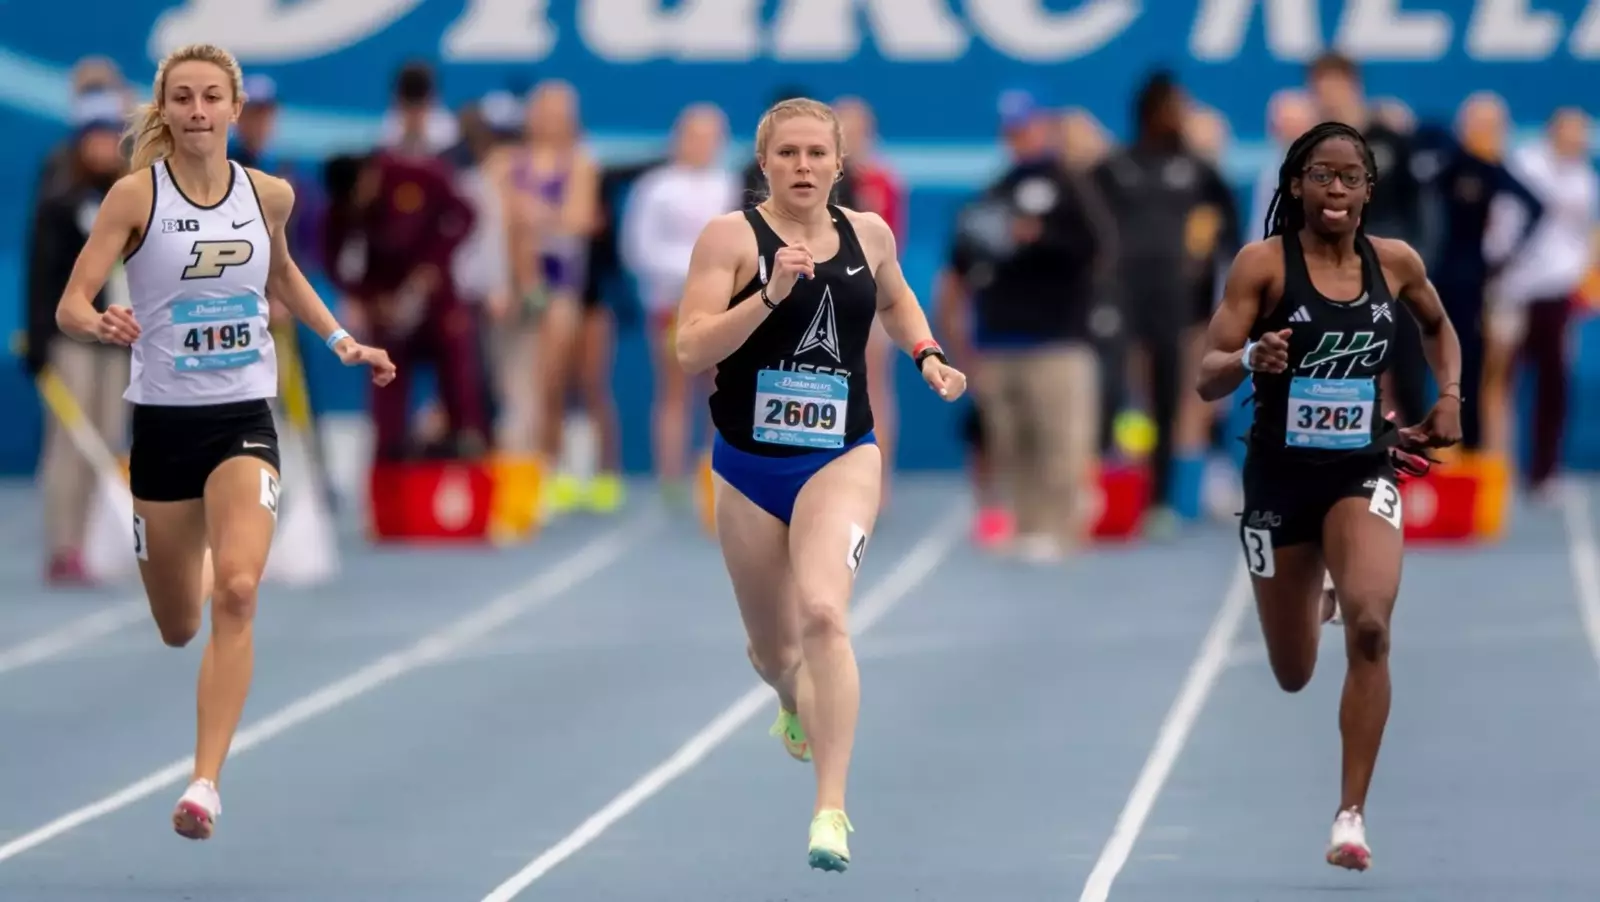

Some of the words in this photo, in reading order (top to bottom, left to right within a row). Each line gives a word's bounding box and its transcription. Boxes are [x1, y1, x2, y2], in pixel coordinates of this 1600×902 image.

[180, 239, 254, 281] P
[184, 323, 251, 352] 4195
[764, 399, 837, 430] 2609
[1297, 405, 1364, 431] 3262
[1377, 484, 1398, 519] 3
[1248, 532, 1266, 573] 3
